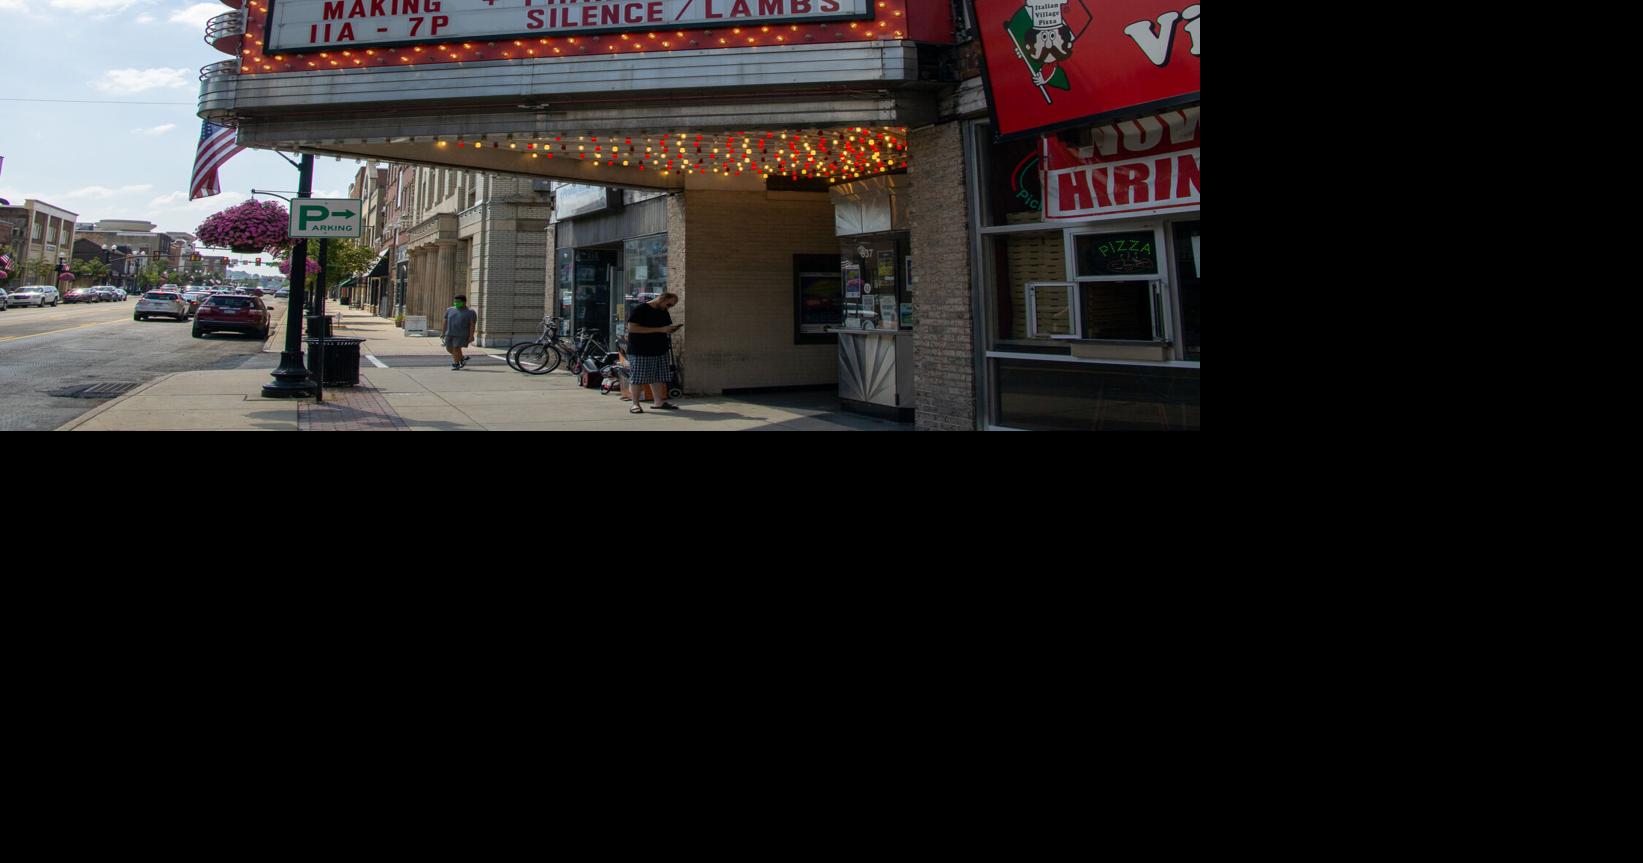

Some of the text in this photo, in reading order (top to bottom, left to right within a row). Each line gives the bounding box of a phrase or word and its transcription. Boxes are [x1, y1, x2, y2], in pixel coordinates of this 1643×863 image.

[323, 0, 441, 20] MAKING
[526, 2, 664, 30] SILENCE
[705, 0, 841, 19] LAMBS
[1098, 239, 1151, 257] PIZZA
